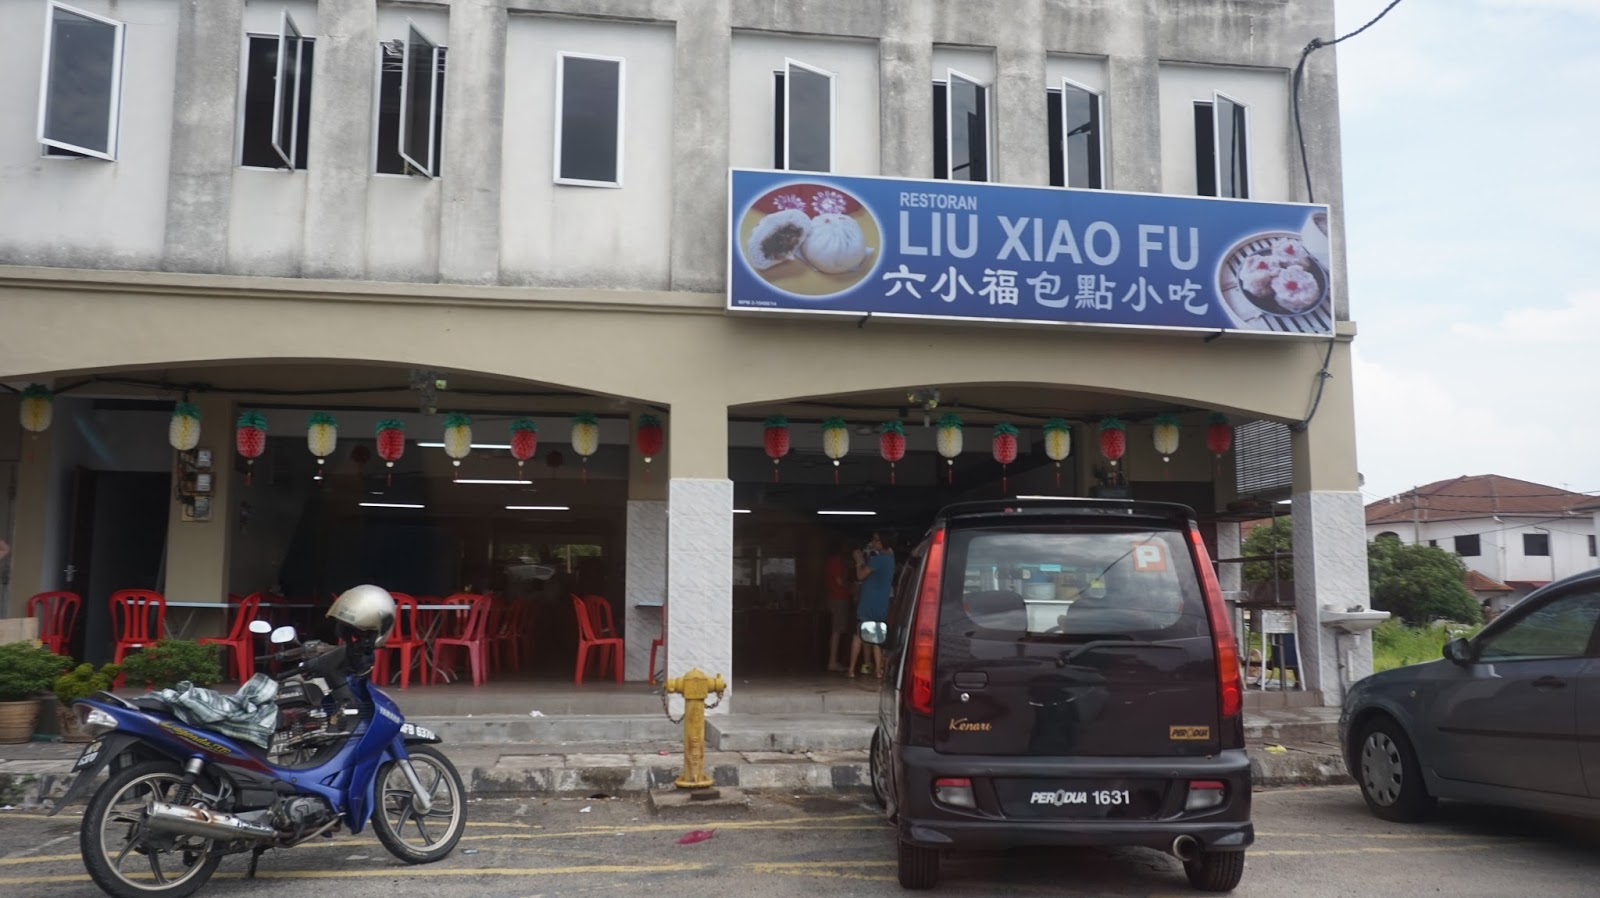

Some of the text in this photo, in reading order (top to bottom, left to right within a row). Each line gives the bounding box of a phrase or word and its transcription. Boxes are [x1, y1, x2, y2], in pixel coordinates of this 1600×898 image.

[900, 192, 977, 211] RESTORAN
[900, 210, 1199, 271] LIU XIAO FU
[882, 264, 1209, 315] 六小福包點小吃
[1136, 545, 1161, 568] P
[1030, 789, 1130, 807] PERODUA 1631
